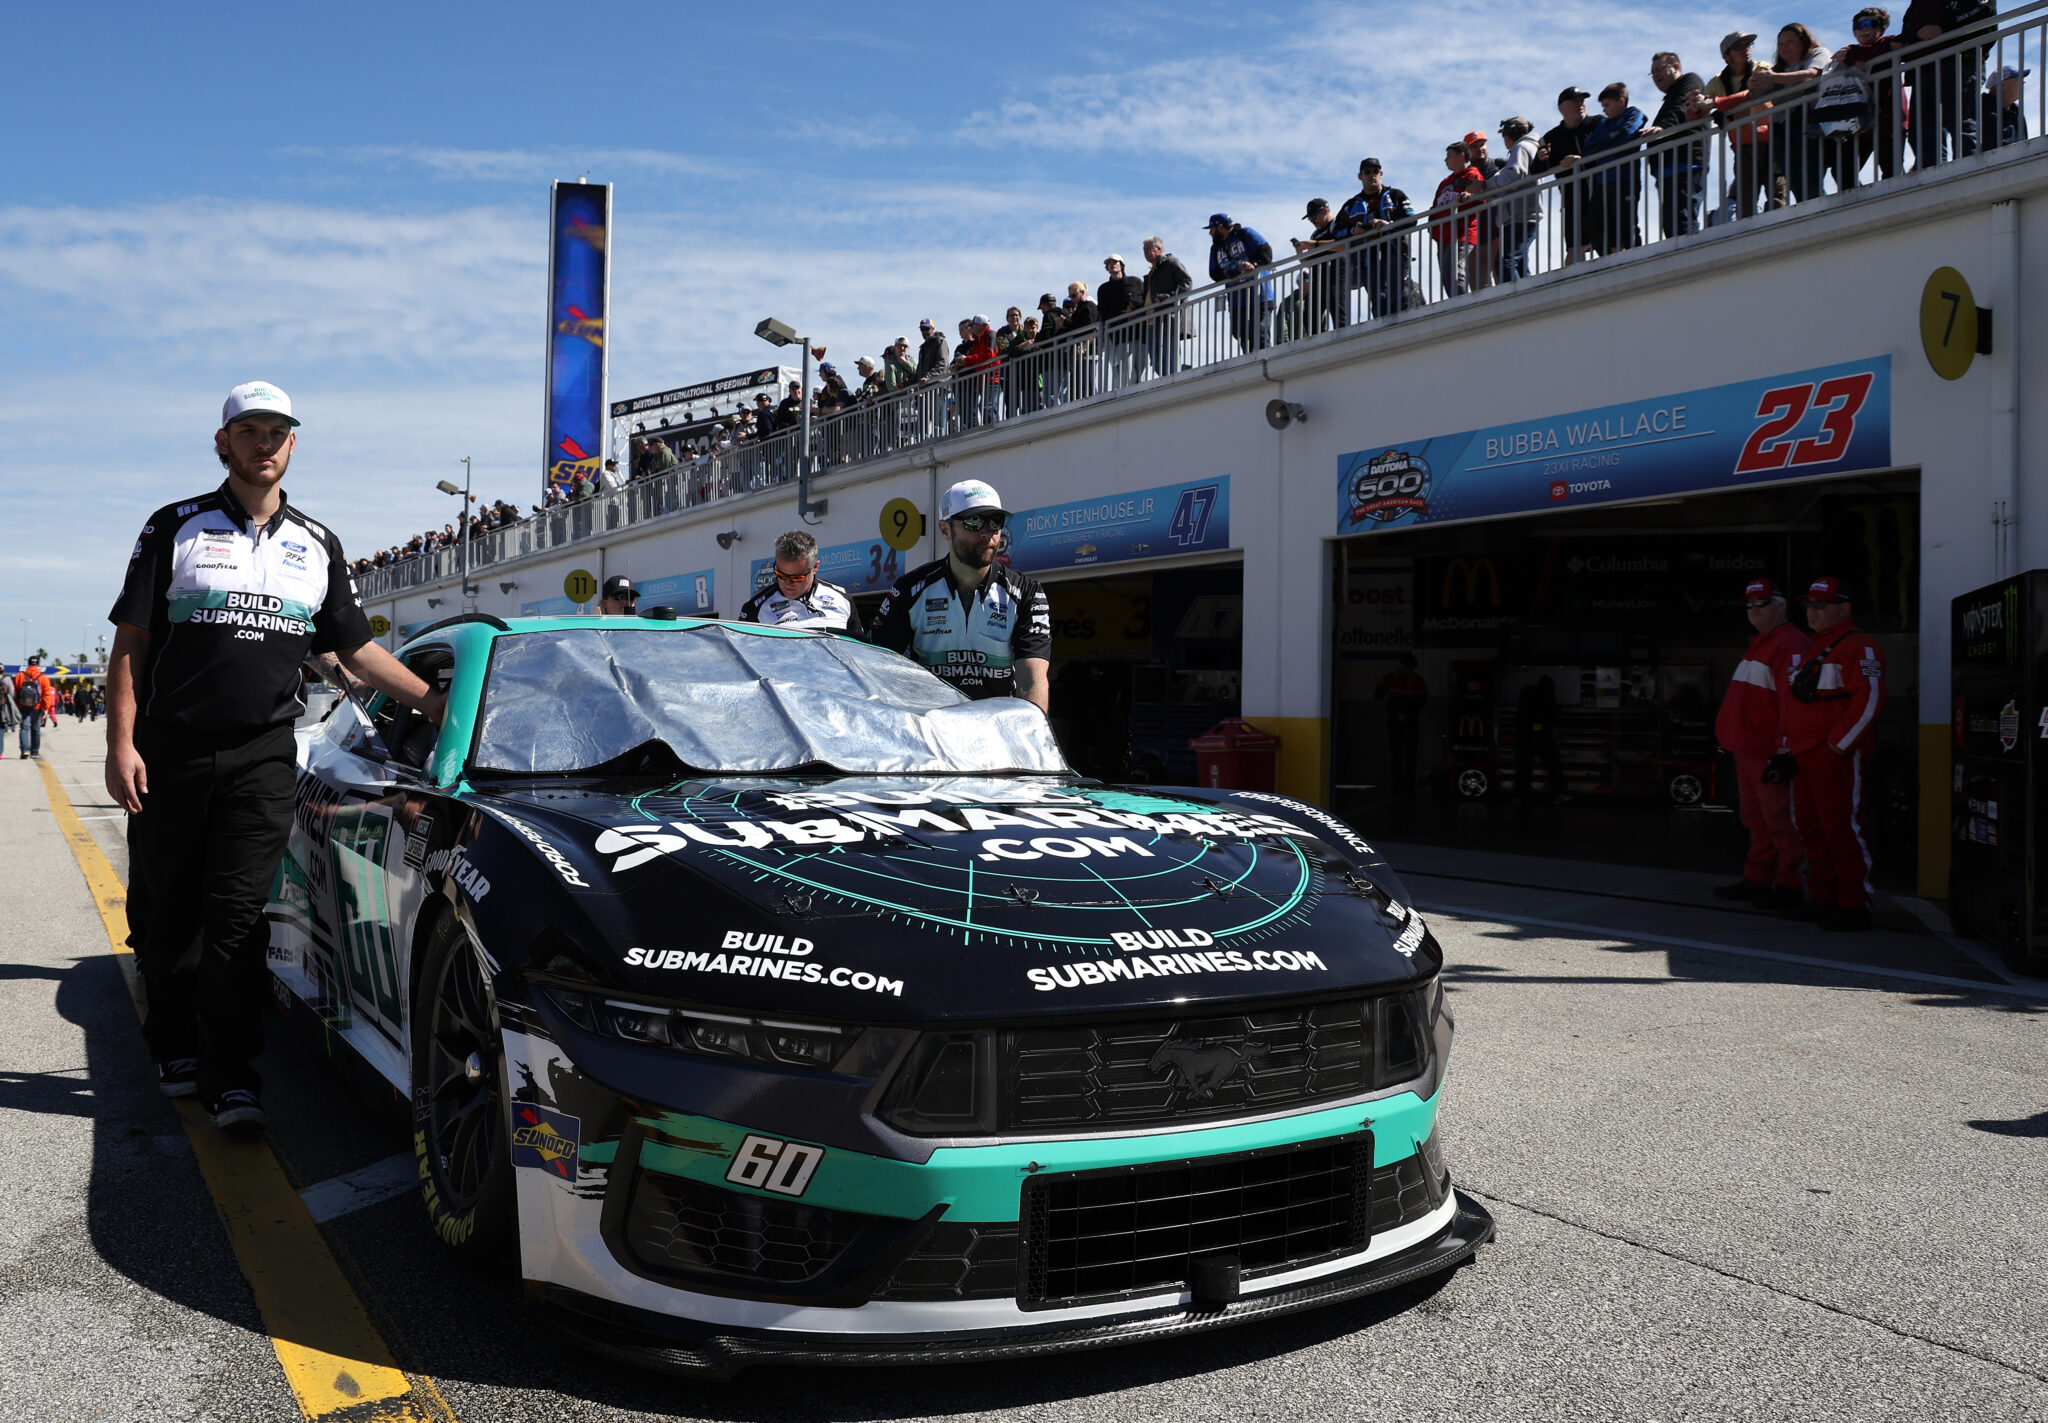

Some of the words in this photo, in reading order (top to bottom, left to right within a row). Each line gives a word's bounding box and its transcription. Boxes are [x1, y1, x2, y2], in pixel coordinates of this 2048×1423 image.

[1941, 291, 1960, 347] 7
[632, 396, 661, 411] DAYTONA
[663, 383, 713, 404] INTERNATIONAL
[715, 375, 752, 392] SPEEDWAY
[1486, 428, 1559, 460] BUBBA
[1567, 406, 1687, 449] WALLACE
[1733, 371, 1876, 476] 23
[1370, 459, 1409, 475] DAYTONA
[1543, 462, 1570, 476] 23XI
[1572, 453, 1621, 471] RACING
[1358, 471, 1422, 500] 500
[1569, 479, 1612, 494] TOYOTA
[893, 509, 907, 538] 9
[1026, 512, 1059, 532] RICKY
[1060, 501, 1137, 528] STENHOUSE
[1138, 498, 1154, 516] JR
[1168, 484, 1219, 546] 47
[196, 562, 238, 570] GOODYEAR
[865, 543, 899, 585] 34
[1586, 555, 1669, 573] Columbia
[1708, 554, 1768, 572] leidos
[573, 577, 588, 595] 11
[695, 574, 709, 609] 8
[226, 592, 283, 612] BUILD
[1592, 599, 1657, 612] MoneyLion
[190, 608, 308, 636] SUBMARINES
[371, 620, 385, 633] 13
[1421, 617, 1520, 632] McDonal
[1963, 601, 2004, 640] MONSTER
[233, 629, 265, 642] .COM
[1334, 627, 1416, 646] ottonelle
[946, 650, 987, 665] BUILD
[959, 678, 983, 687] .COM
[1278, 796, 1376, 854] PERFORMANCE
[978, 835, 1155, 862] .COM
[424, 844, 491, 904] GOODYEAR
[721, 930, 814, 956] BUILD
[1110, 928, 1213, 952] BUILD
[623, 947, 905, 998] SUBMARINES.COM
[1026, 950, 1328, 992] SUBMARINES.COM
[514, 1129, 574, 1157] SUNOCO
[725, 1134, 825, 1197] 60
